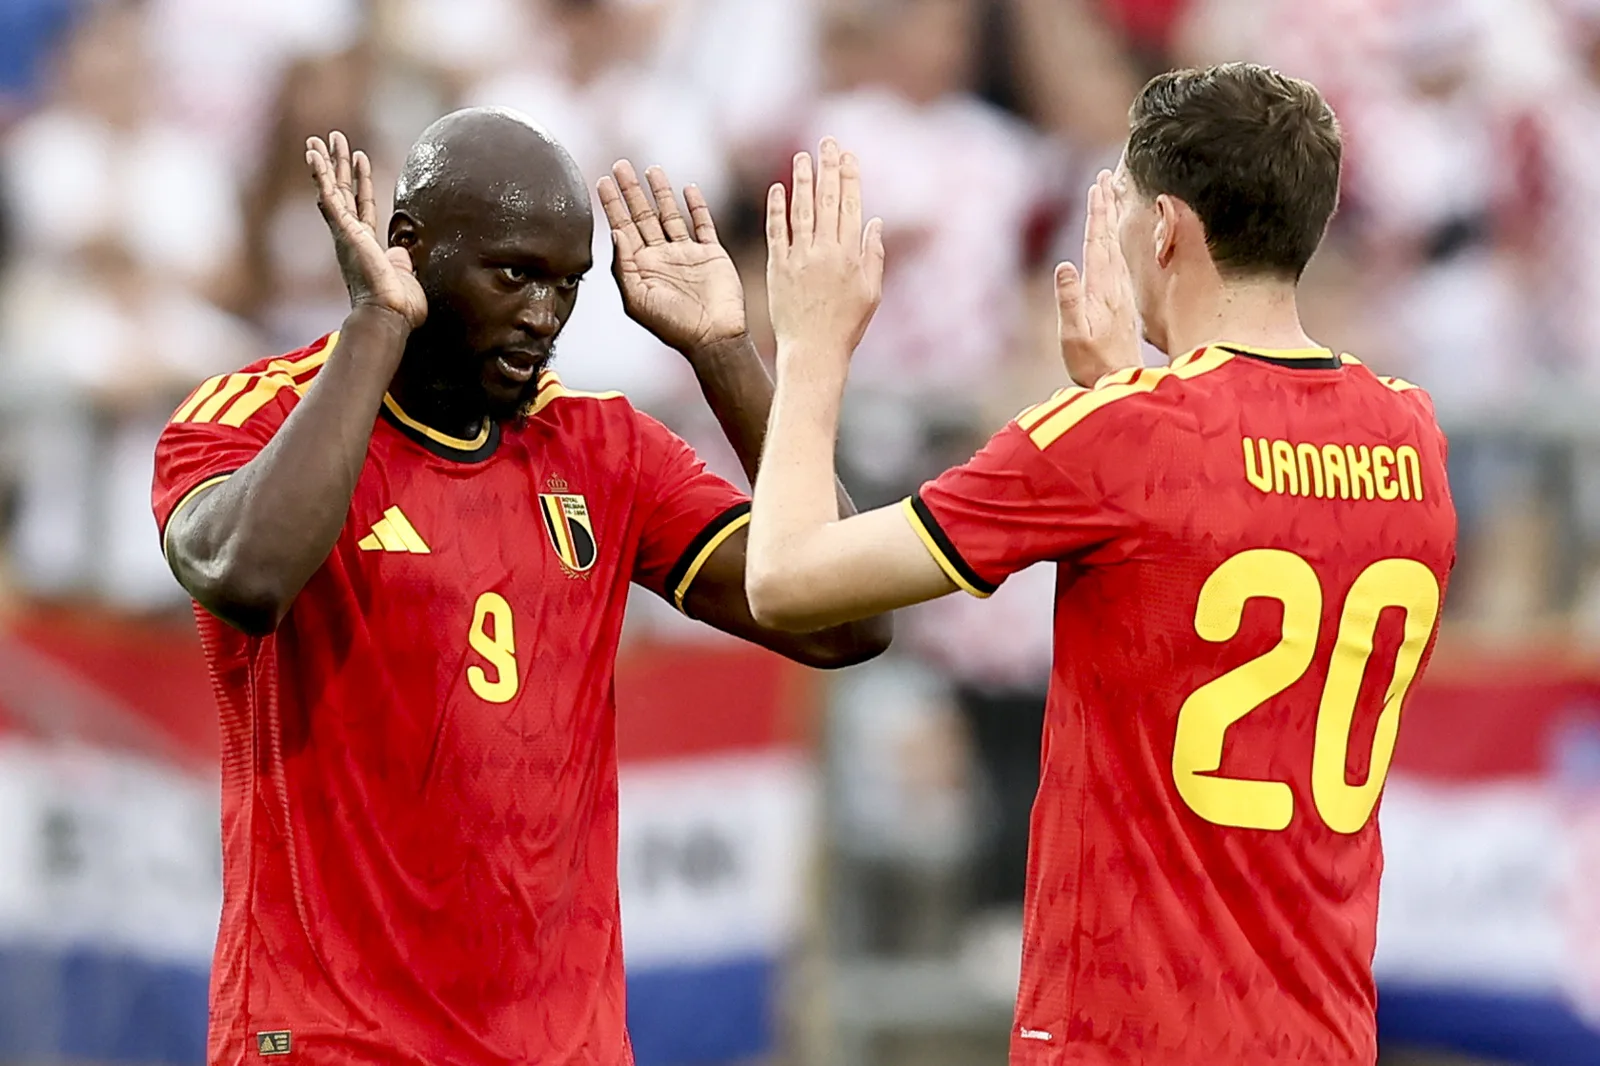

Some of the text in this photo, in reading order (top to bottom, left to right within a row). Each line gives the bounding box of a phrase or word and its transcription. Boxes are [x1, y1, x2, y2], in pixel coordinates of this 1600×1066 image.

[1243, 437, 1422, 502] VANAKEN
[466, 592, 520, 704] 9
[1172, 548, 1440, 834] 20
